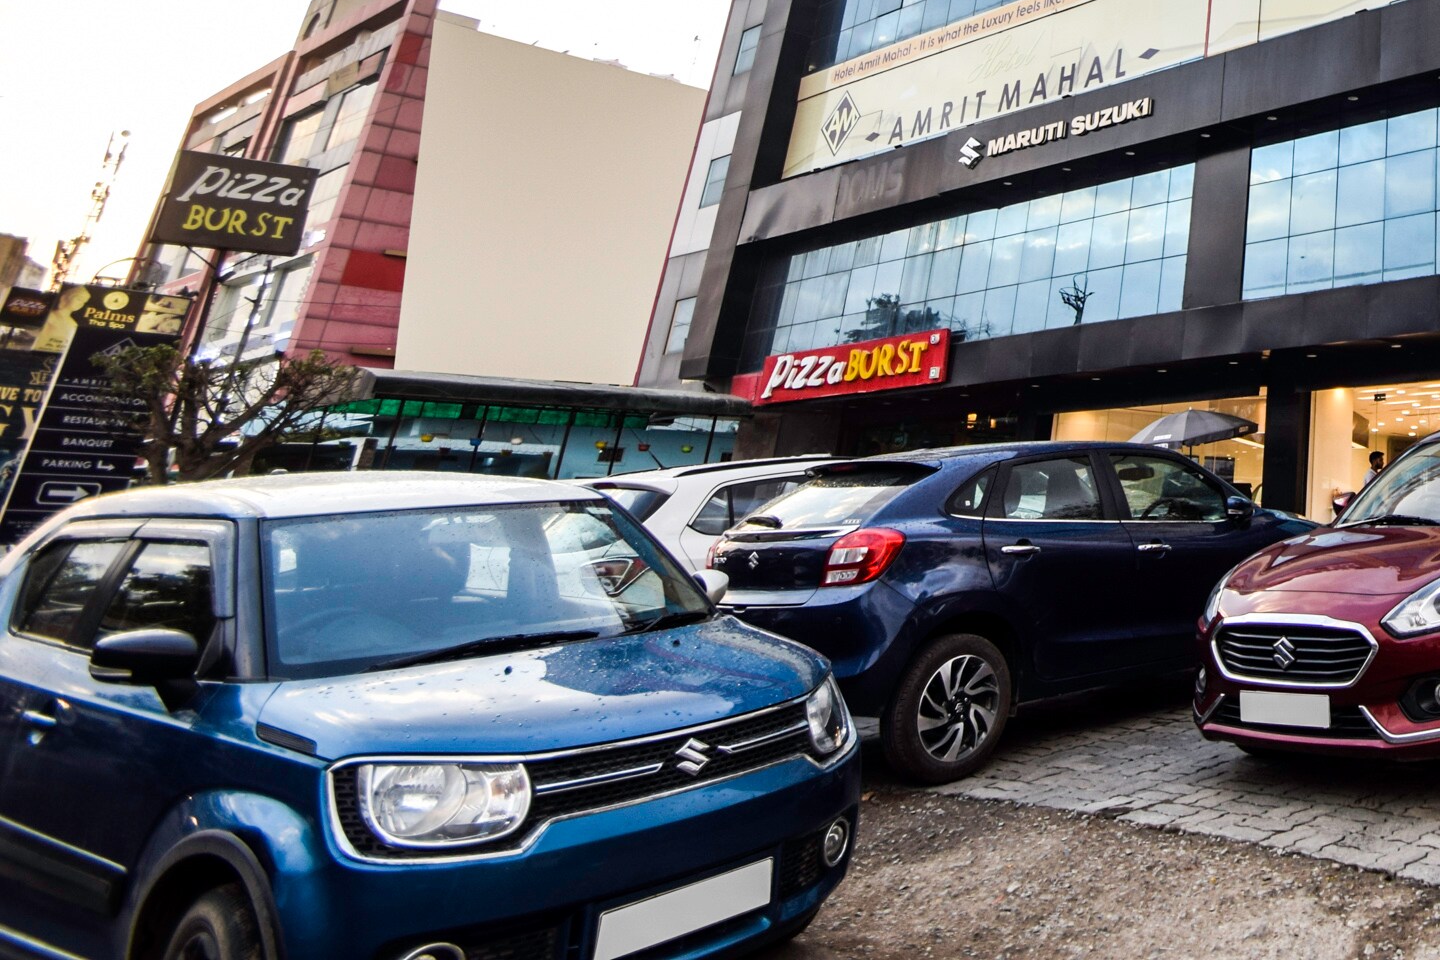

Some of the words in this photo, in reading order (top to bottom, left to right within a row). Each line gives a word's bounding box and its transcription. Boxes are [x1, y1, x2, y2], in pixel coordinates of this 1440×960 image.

[834, 66, 856, 82] Hotel
[858, 57, 881, 73] Amrit
[883, 44, 912, 68] Mahal
[920, 39, 926, 52] It
[928, 37, 935, 49] is
[937, 26, 961, 45] what
[963, 21, 979, 38] the
[981, 10, 1014, 33] Luxury
[1016, 0, 1041, 19] feels
[888, 90, 986, 145] AMRIT
[998, 49, 1127, 112] MAHAL
[986, 120, 1068, 157] MARUTI
[1070, 96, 1153, 136] SUZUKI
[182, 205, 293, 239] BURST
[84, 307, 136, 323] Palms
[844, 340, 928, 381] BURST
[0, 386, 20, 401] VE
[62, 437, 114, 448] BANQUET
[42, 458, 92, 469] PARKING
